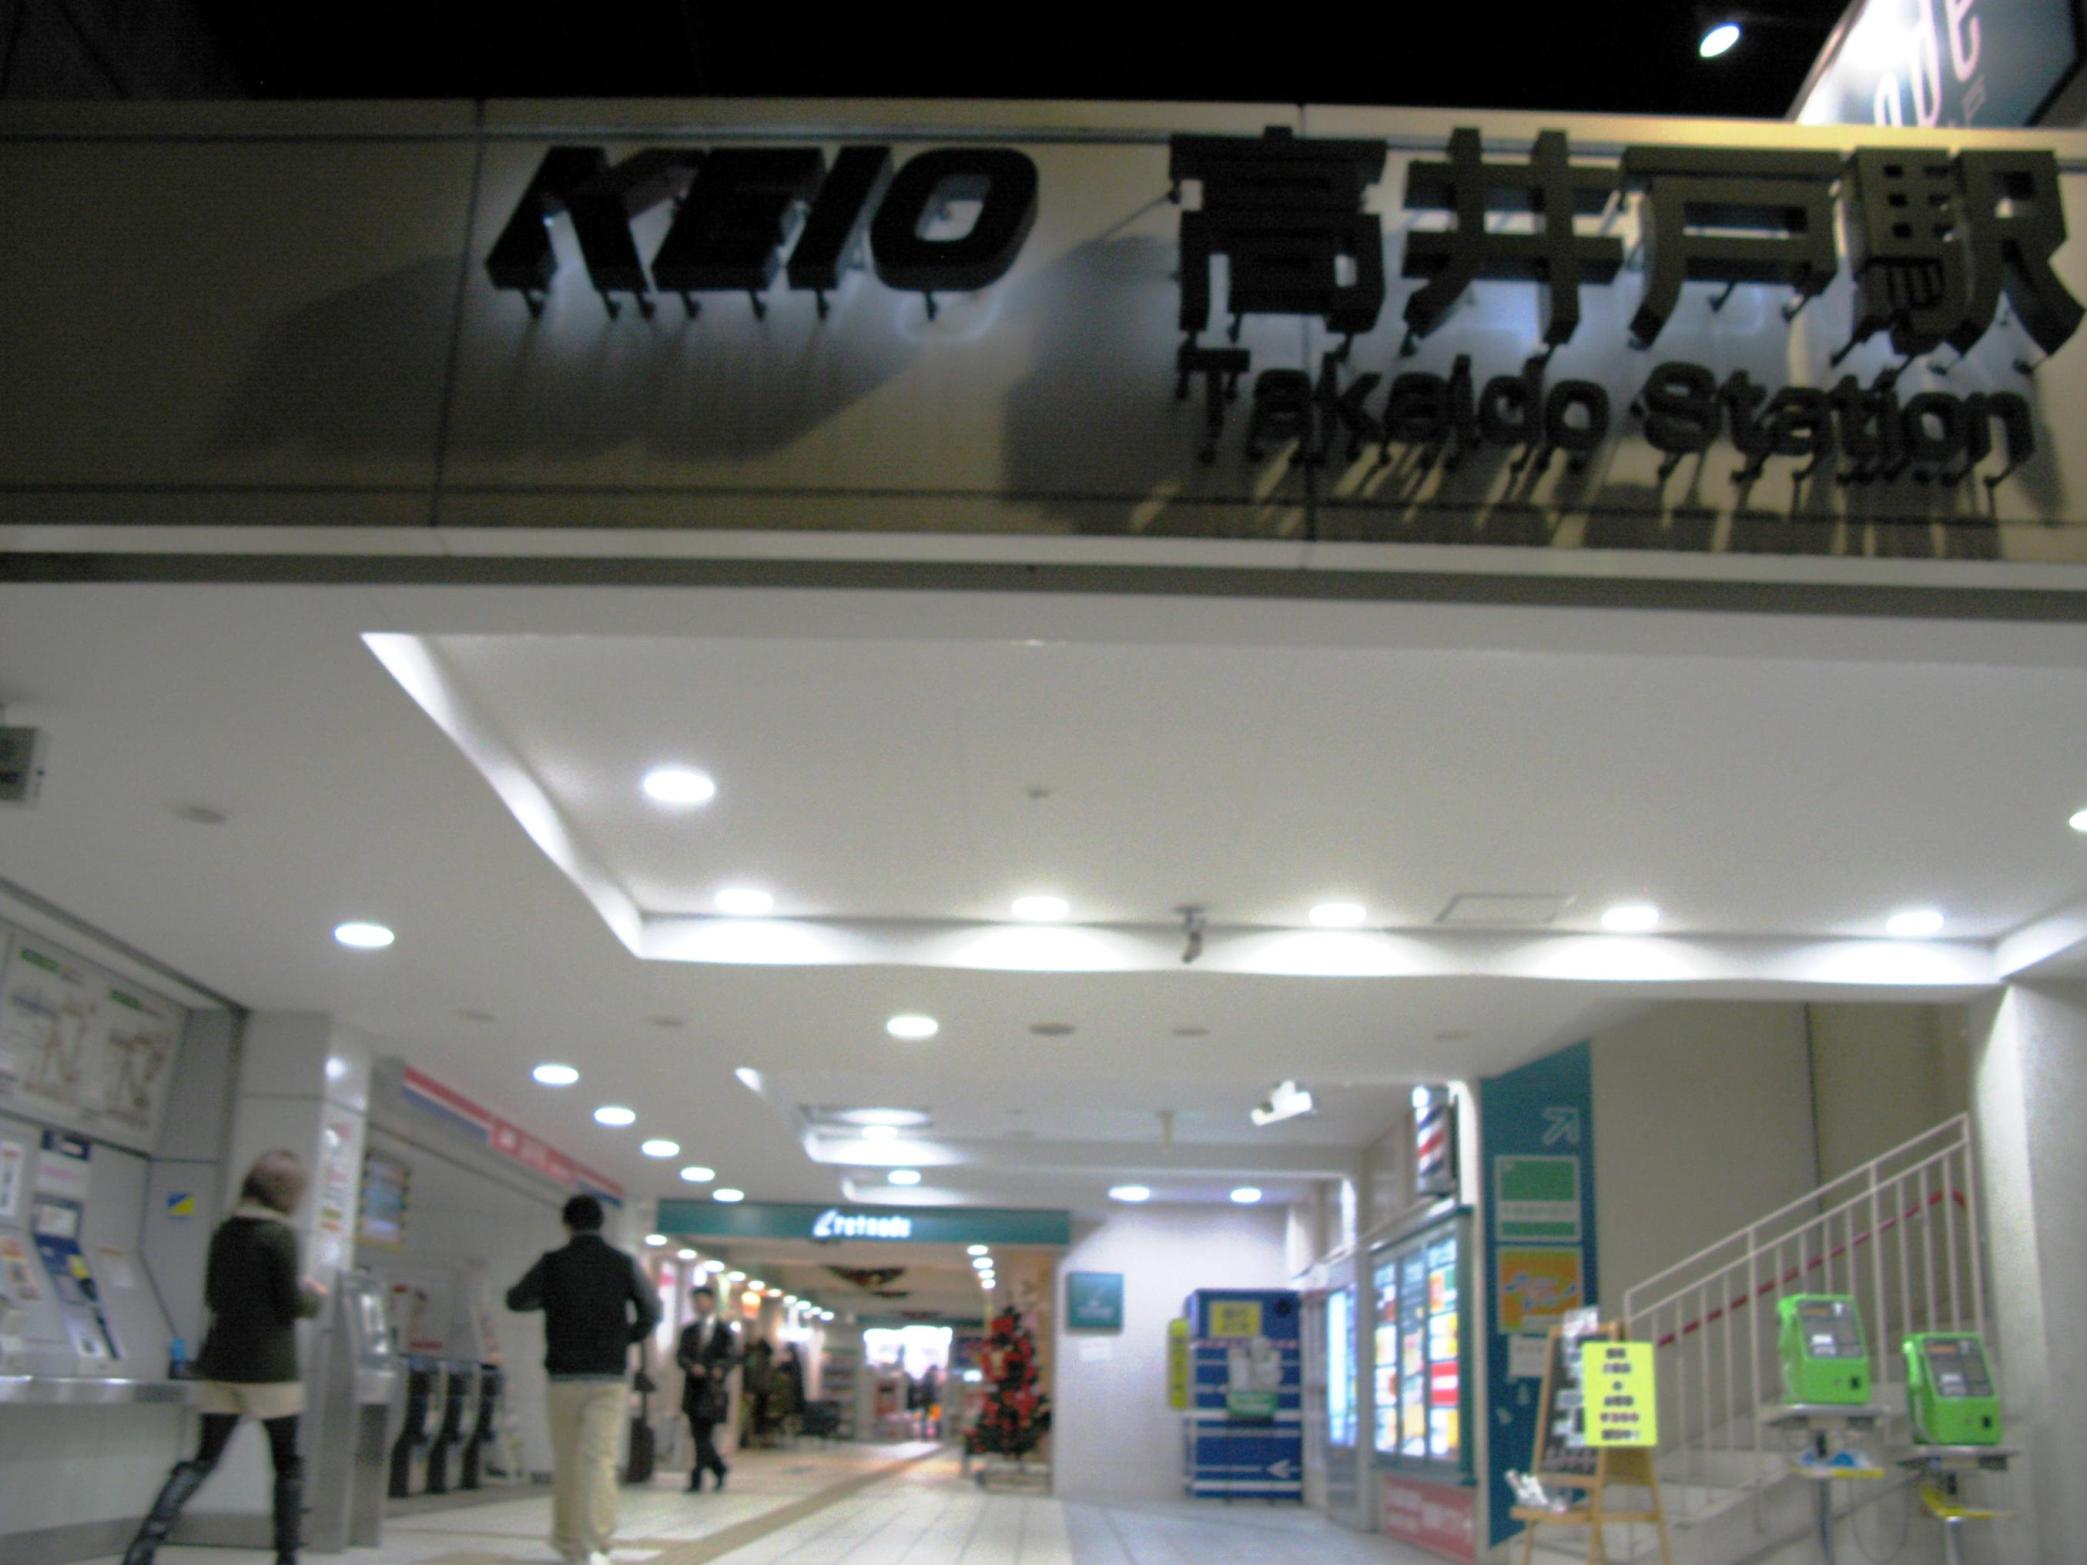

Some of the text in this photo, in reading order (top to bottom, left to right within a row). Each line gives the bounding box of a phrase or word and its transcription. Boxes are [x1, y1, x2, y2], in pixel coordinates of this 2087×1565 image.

[486, 145, 1038, 291] KEIO
[1170, 126, 2085, 356] 高井戸駅
[1178, 348, 2036, 462] Takaido Station
